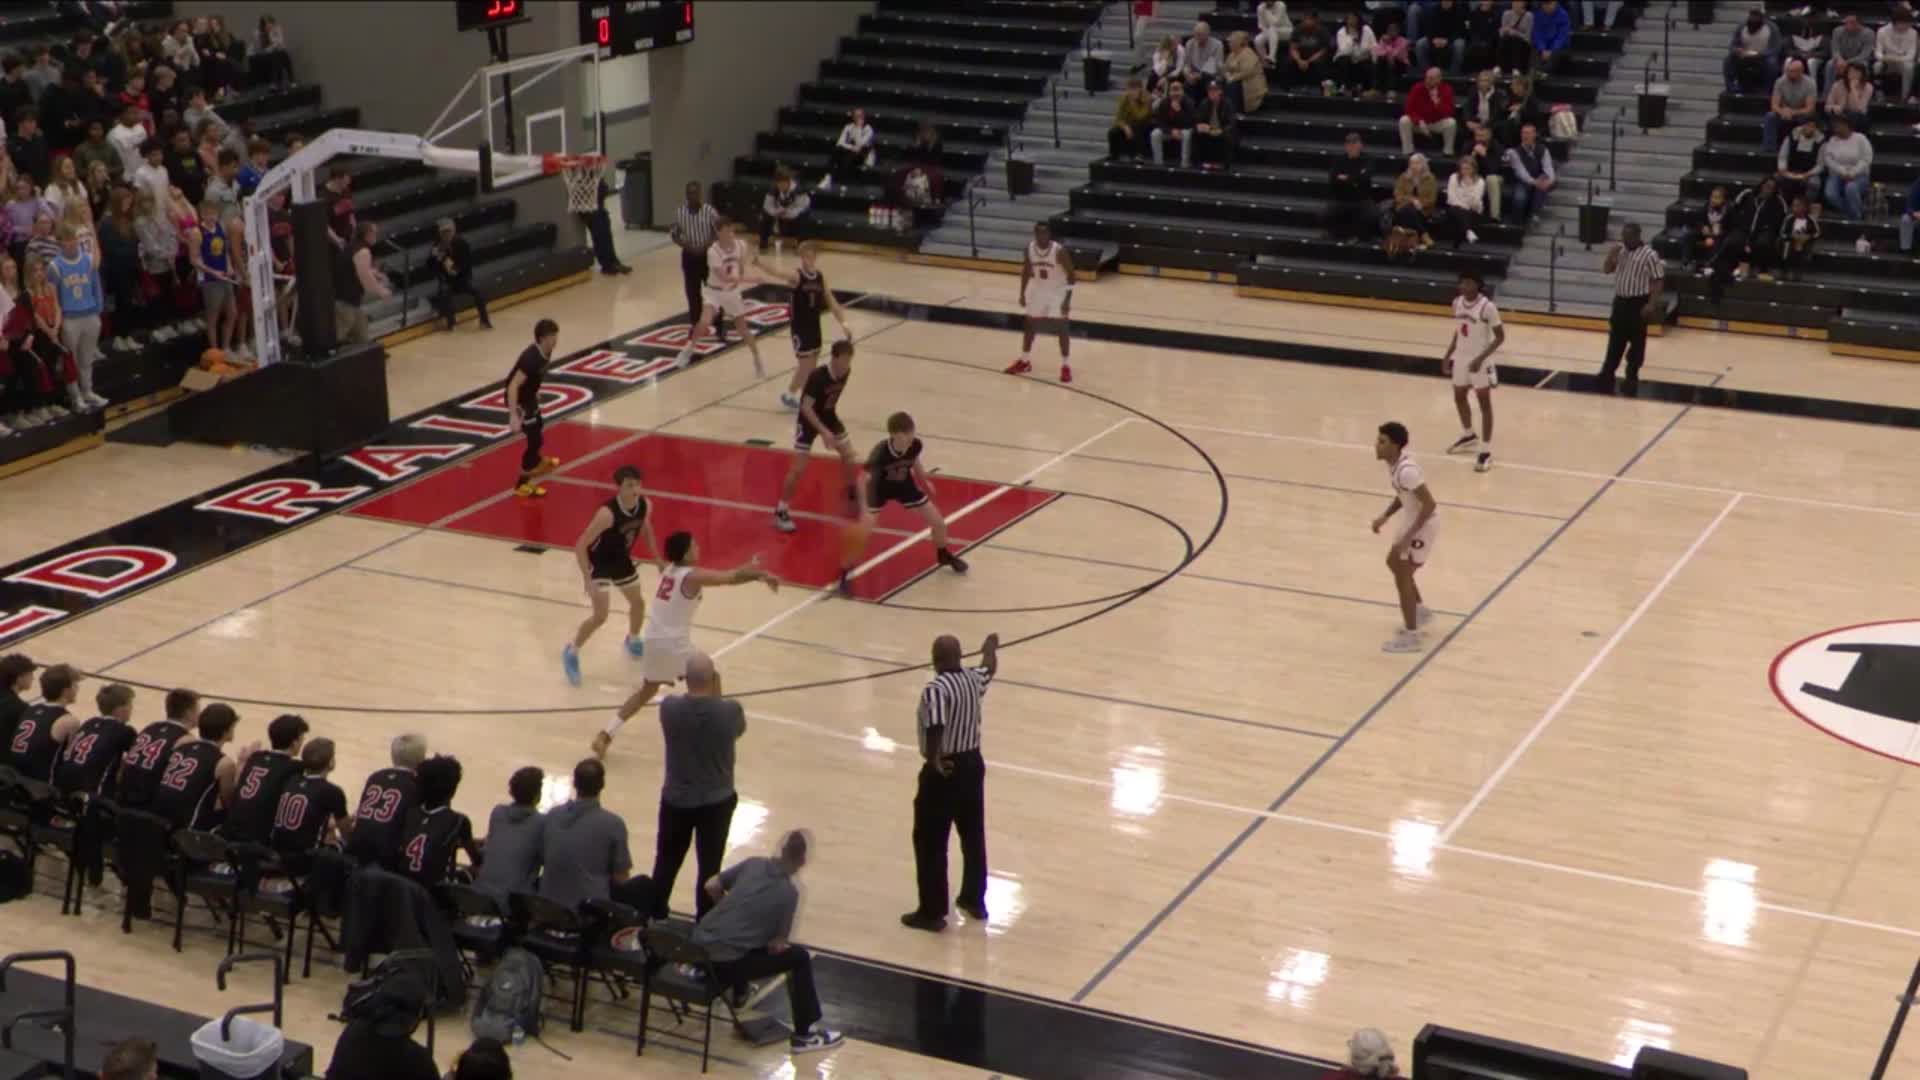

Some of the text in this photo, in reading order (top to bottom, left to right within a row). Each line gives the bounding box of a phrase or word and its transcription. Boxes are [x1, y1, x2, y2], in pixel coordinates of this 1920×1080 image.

[599, 19, 609, 42] 0
[11, 719, 37, 754] 2
[126, 733, 167, 771] 24
[160, 751, 199, 792] 22
[240, 766, 270, 799] 5
[275, 791, 309, 831] 10
[358, 783, 402, 823] 23
[406, 833, 428, 872] 4
